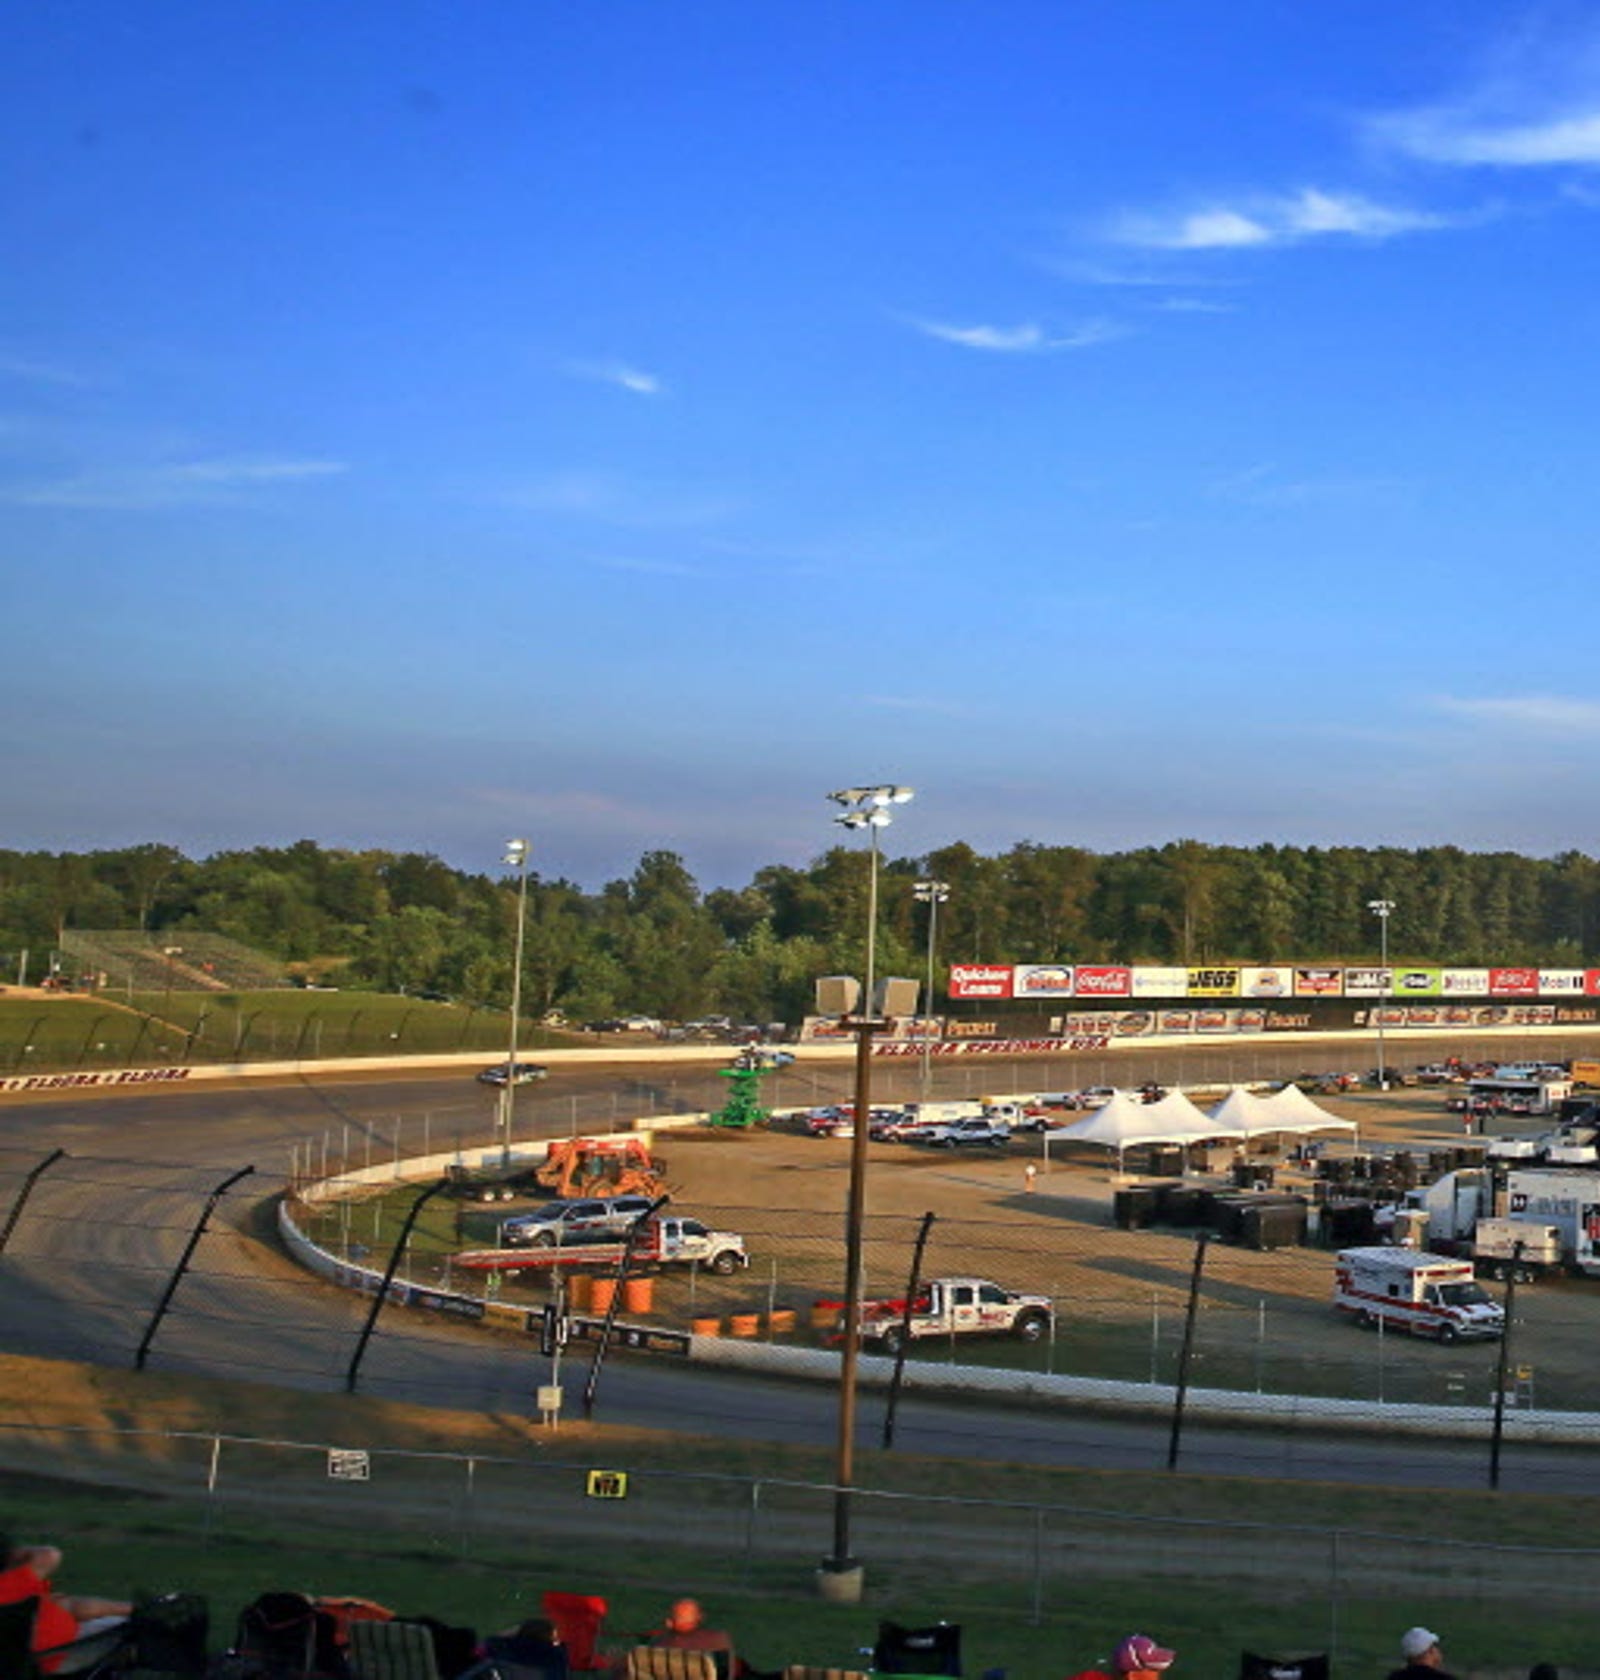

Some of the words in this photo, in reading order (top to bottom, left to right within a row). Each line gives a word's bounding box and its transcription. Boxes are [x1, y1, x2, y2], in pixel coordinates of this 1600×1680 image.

[952, 967, 1011, 982] Quicken
[960, 983, 1003, 995] Loans
[1539, 976, 1570, 989] Mobil
[964, 1039, 1068, 1054] SPEEDWAY
[1071, 1037, 1110, 1050] USA
[23, 1074, 98, 1090] ELDORA
[117, 1069, 190, 1084] ELDORA
